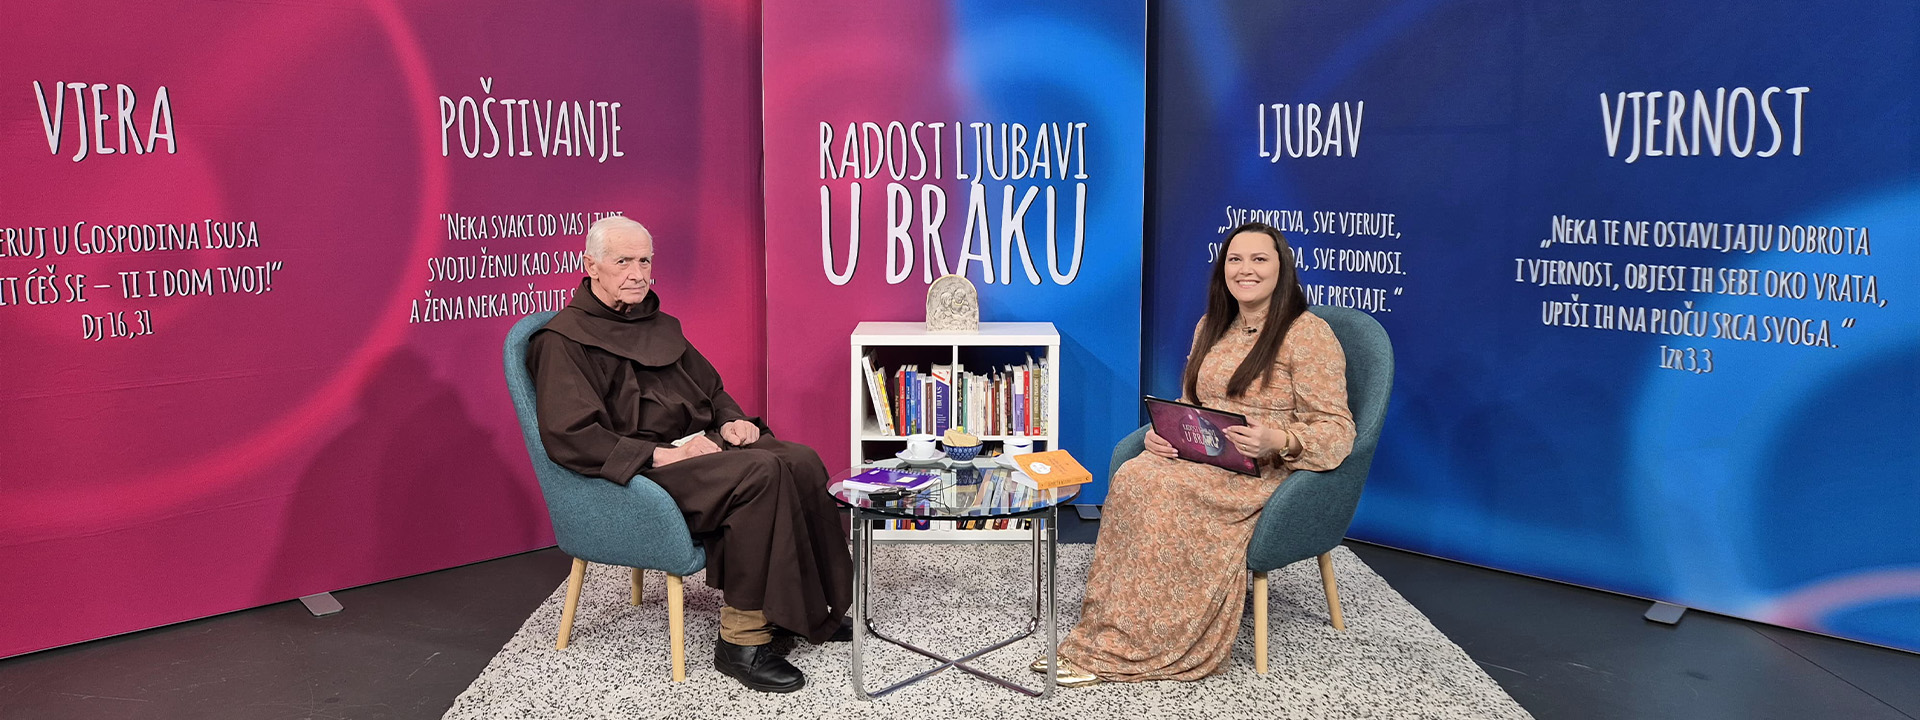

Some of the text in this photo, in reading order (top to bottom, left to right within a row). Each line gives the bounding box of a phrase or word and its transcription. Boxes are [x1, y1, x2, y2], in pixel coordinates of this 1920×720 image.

[33, 81, 174, 162] VJERA
[439, 77, 624, 162] POŠTIVANJE
[1260, 101, 1363, 163] LJUBAV
[1600, 87, 1810, 163] VJERNOST
[820, 121, 1088, 186] RADOST LJUBAVI
[0, 218, 259, 259] ERUJ U GOSPODINA ISUSA
[491, 214, 535, 239] SVAKI
[537, 213, 557, 237] OD
[559, 212, 584, 236] VAS
[820, 182, 1087, 286] U BRAKU
[1250, 209, 1309, 235] POKRIVA,
[1313, 210, 1336, 234] SVE
[1339, 211, 1401, 239] VJERUJE,
[1602, 219, 1621, 246] TE
[1624, 220, 1649, 247] NE
[1653, 220, 1773, 254] OSTAVLJAJU
[1777, 224, 1870, 256] DOBROTA
[428, 246, 584, 282] SVOJU ŽENU KAO SAM
[1207, 242, 1222, 263] SV
[1313, 247, 1336, 271] SVE
[1339, 248, 1407, 276] PODNOSI.
[0, 277, 19, 306] IT
[25, 264, 59, 305] ĆEŠ
[65, 274, 87, 302] SE
[117, 271, 141, 299] TI
[146, 270, 158, 297] I
[163, 268, 213, 297] DOM
[1306, 283, 1325, 306] NE
[1515, 258, 1889, 309] I VJERNOST, OBJESI IH SEBI OKO VRATA,
[82, 309, 154, 342] DJ 16,31
[409, 299, 420, 324] A
[423, 289, 464, 323] ŽENA
[467, 292, 509, 319] NEKA
[1541, 293, 1590, 327] UPIŠI
[1594, 304, 1614, 330] IH
[1617, 306, 1647, 333] NA
[1650, 300, 1710, 338] PLOČU
[1711, 310, 1758, 342] SRCA
[1659, 344, 1714, 375] IZR 3,3
